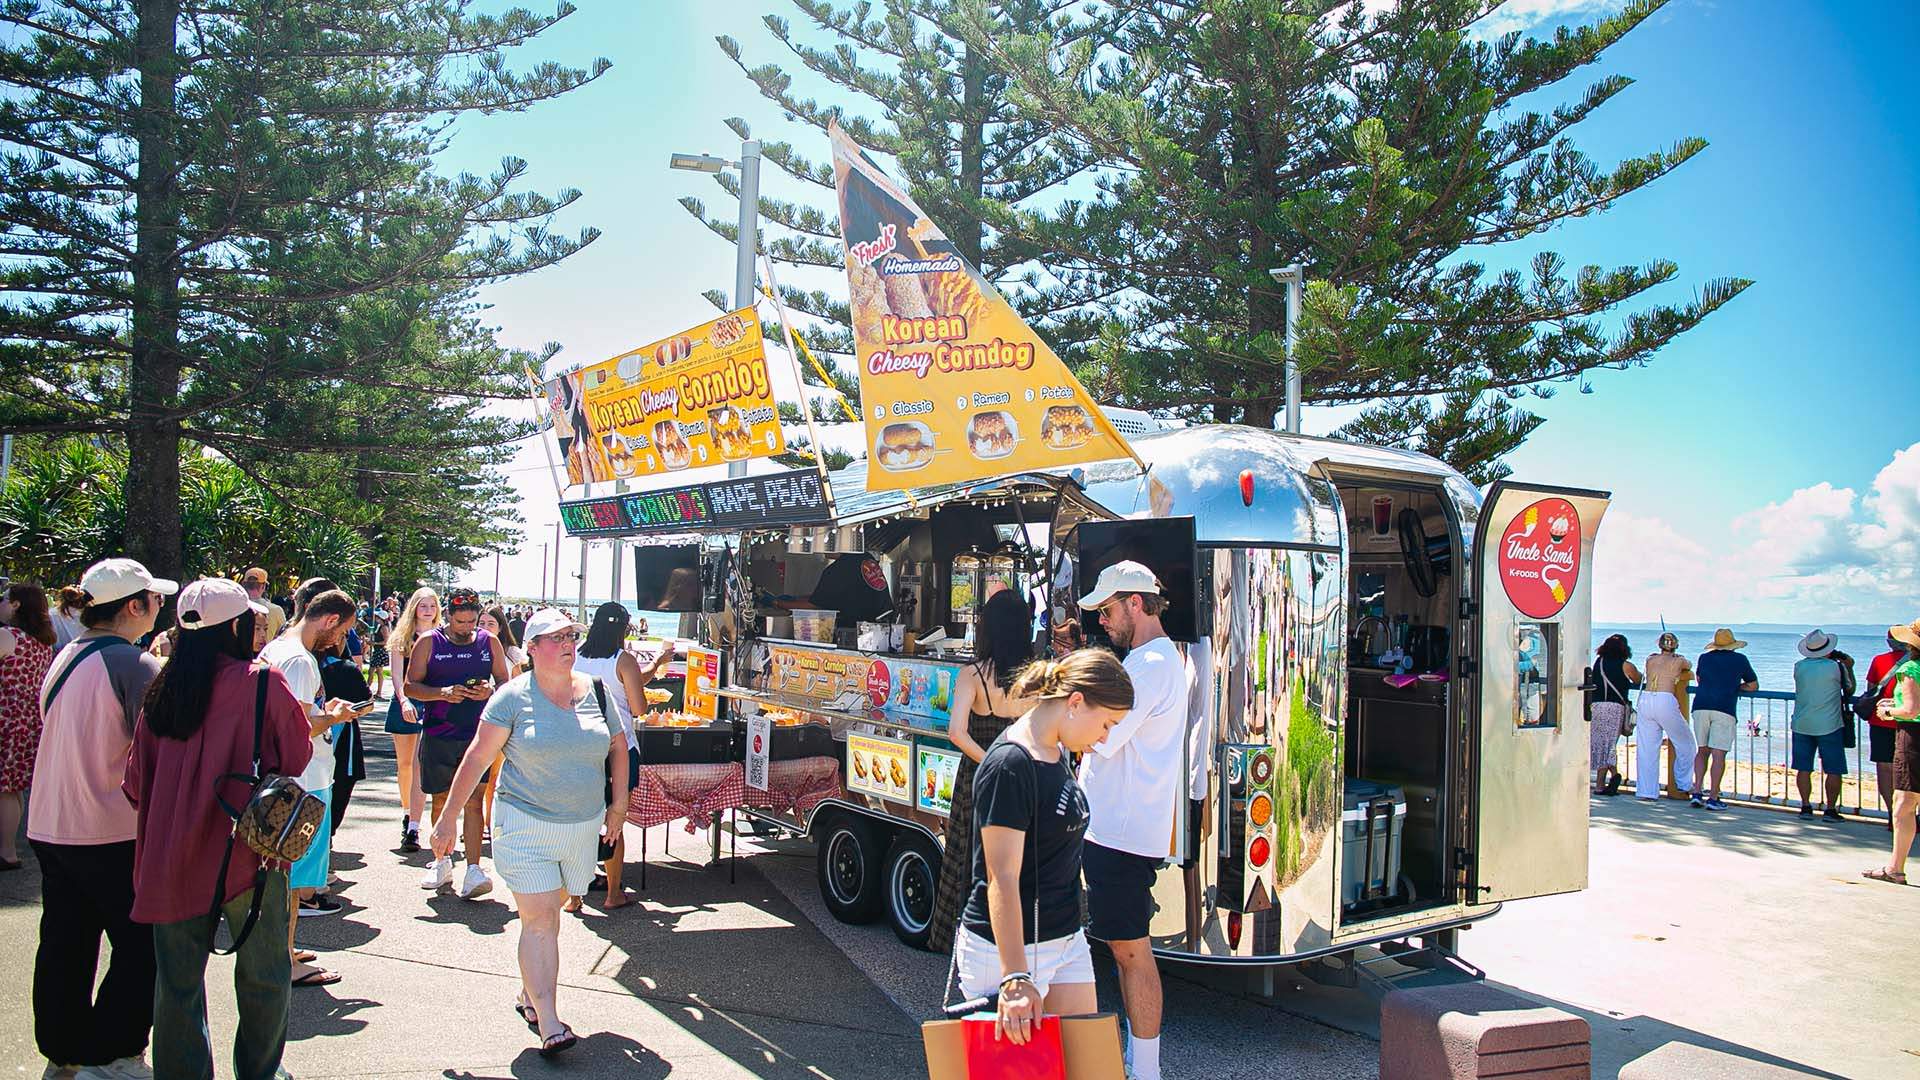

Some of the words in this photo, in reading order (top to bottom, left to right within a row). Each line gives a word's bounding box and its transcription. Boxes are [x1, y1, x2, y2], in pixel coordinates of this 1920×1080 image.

[854, 225, 895, 265] Fresh
[884, 256, 960, 274] Homemade
[882, 314, 967, 343] Korean
[868, 350, 932, 378] Cheesy
[936, 338, 1034, 371] Corndog
[589, 396, 644, 432] Korean
[641, 386, 679, 417] Cheesy
[678, 358, 770, 410] Corndog
[973, 392, 1009, 407] Ramen
[742, 407, 774, 426] Potato
[892, 401, 934, 415] Classic
[627, 491, 706, 524] CORNDOG
[1507, 540, 1540, 560] Uncle
[1541, 544, 1573, 563] Sam's
[1509, 568, 1539, 578] K-FOODS
